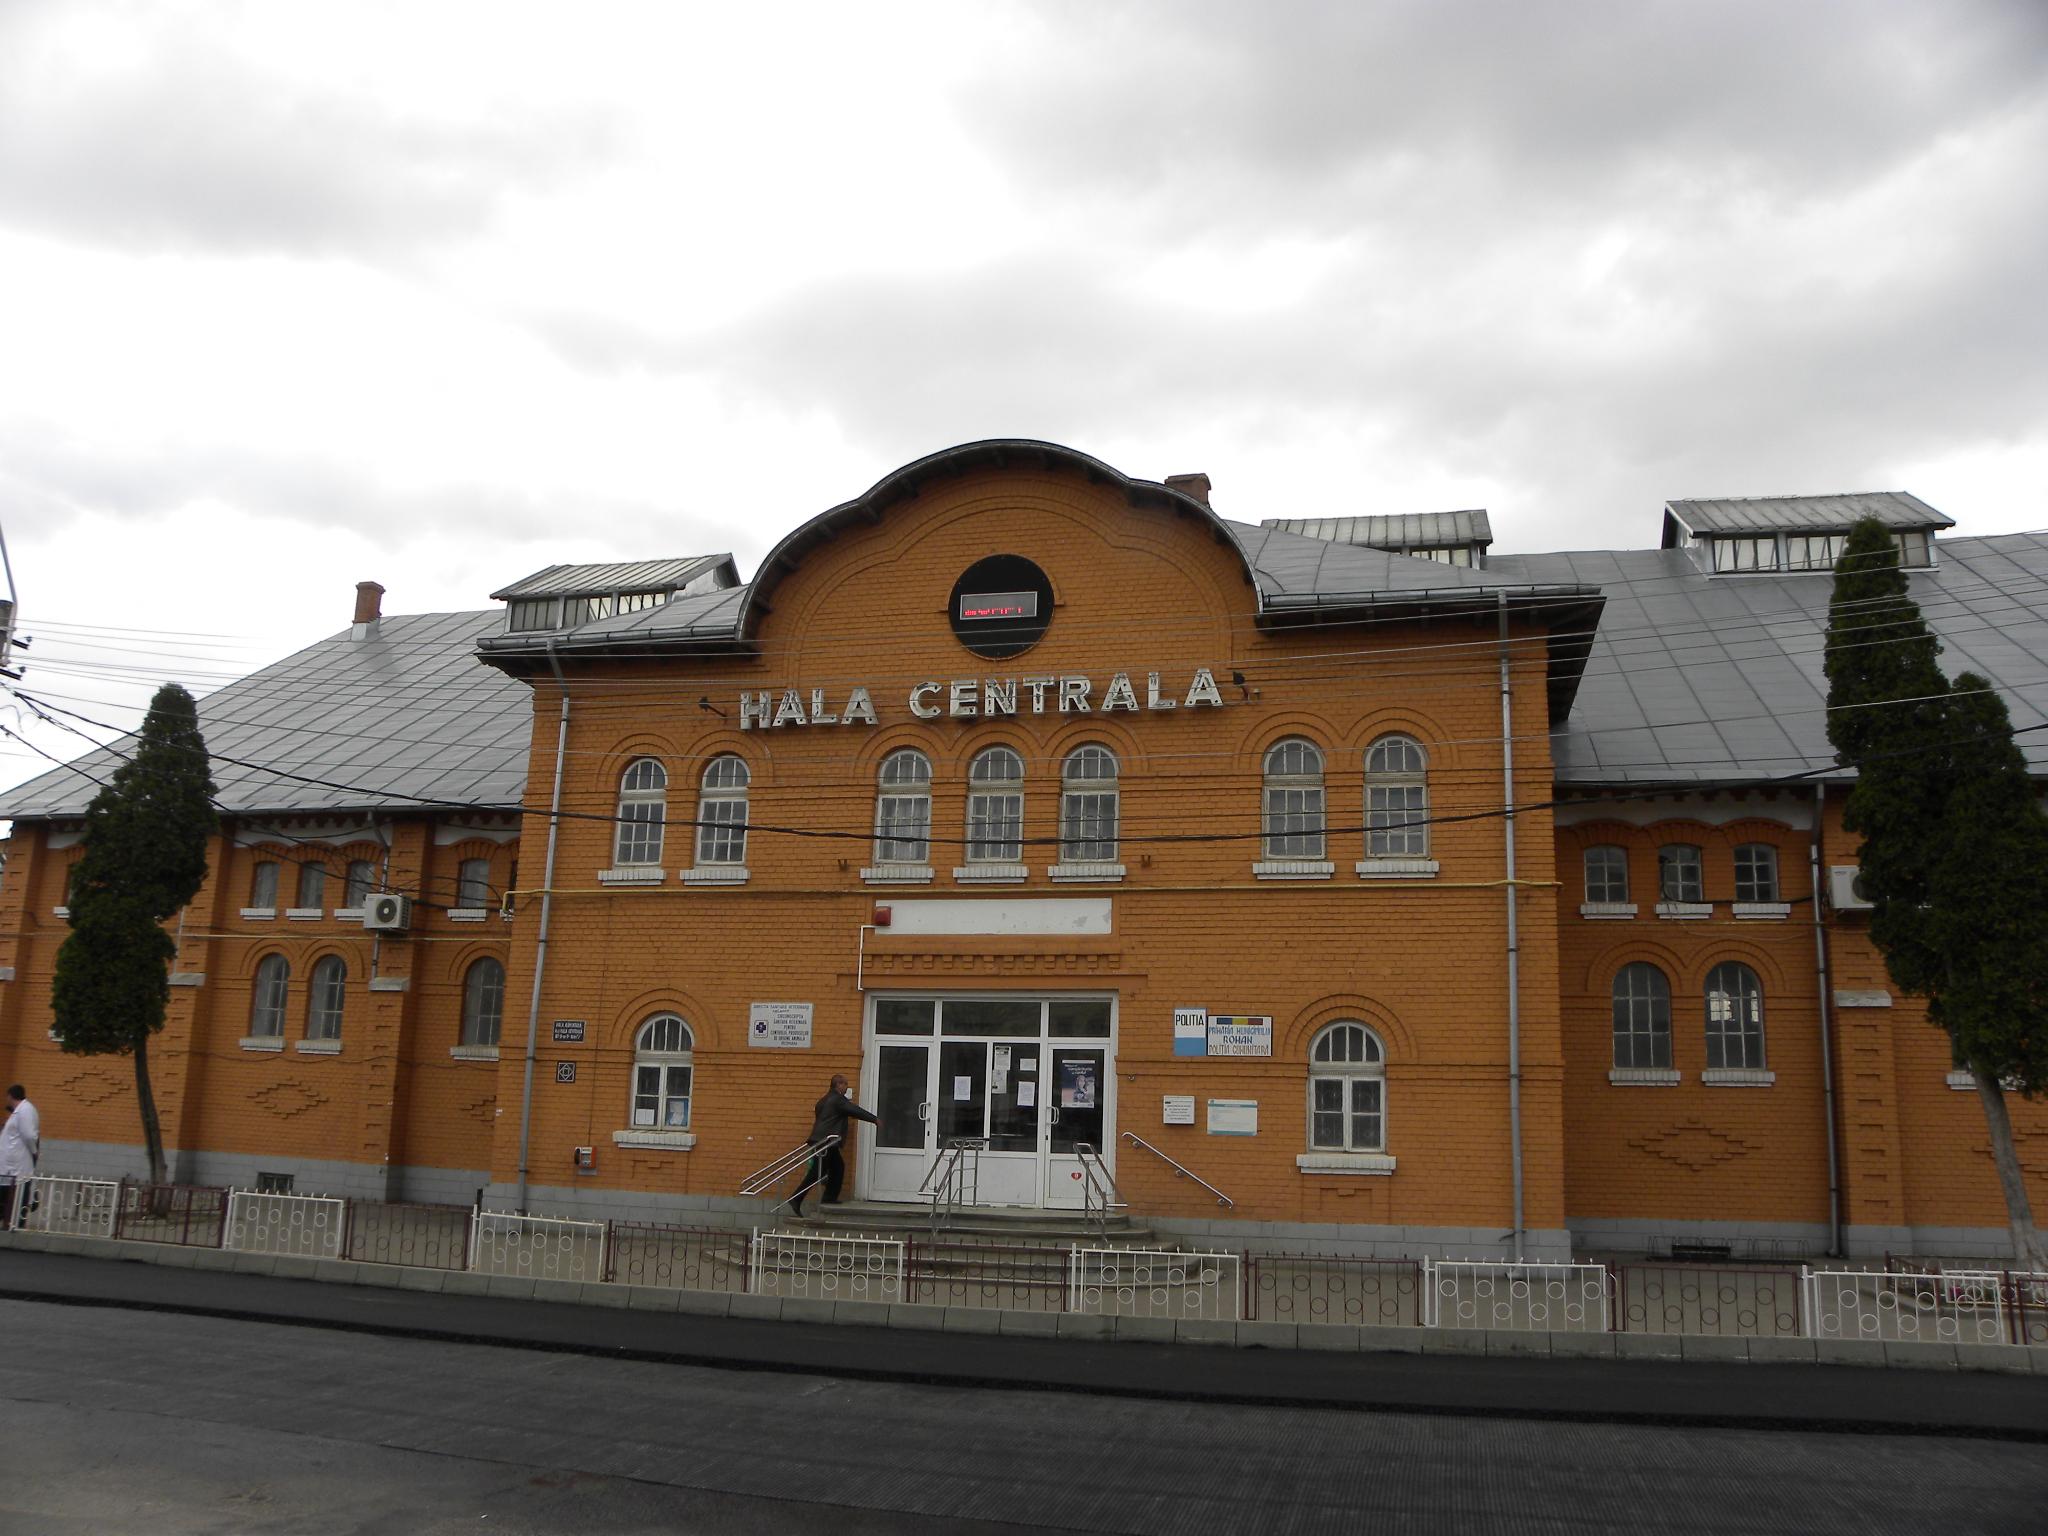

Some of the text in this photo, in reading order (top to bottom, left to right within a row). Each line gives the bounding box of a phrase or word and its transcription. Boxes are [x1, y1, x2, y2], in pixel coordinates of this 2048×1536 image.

[739, 668, 1224, 730] HALA CENTRALA
[1175, 1014, 1205, 1026] POLITIA
